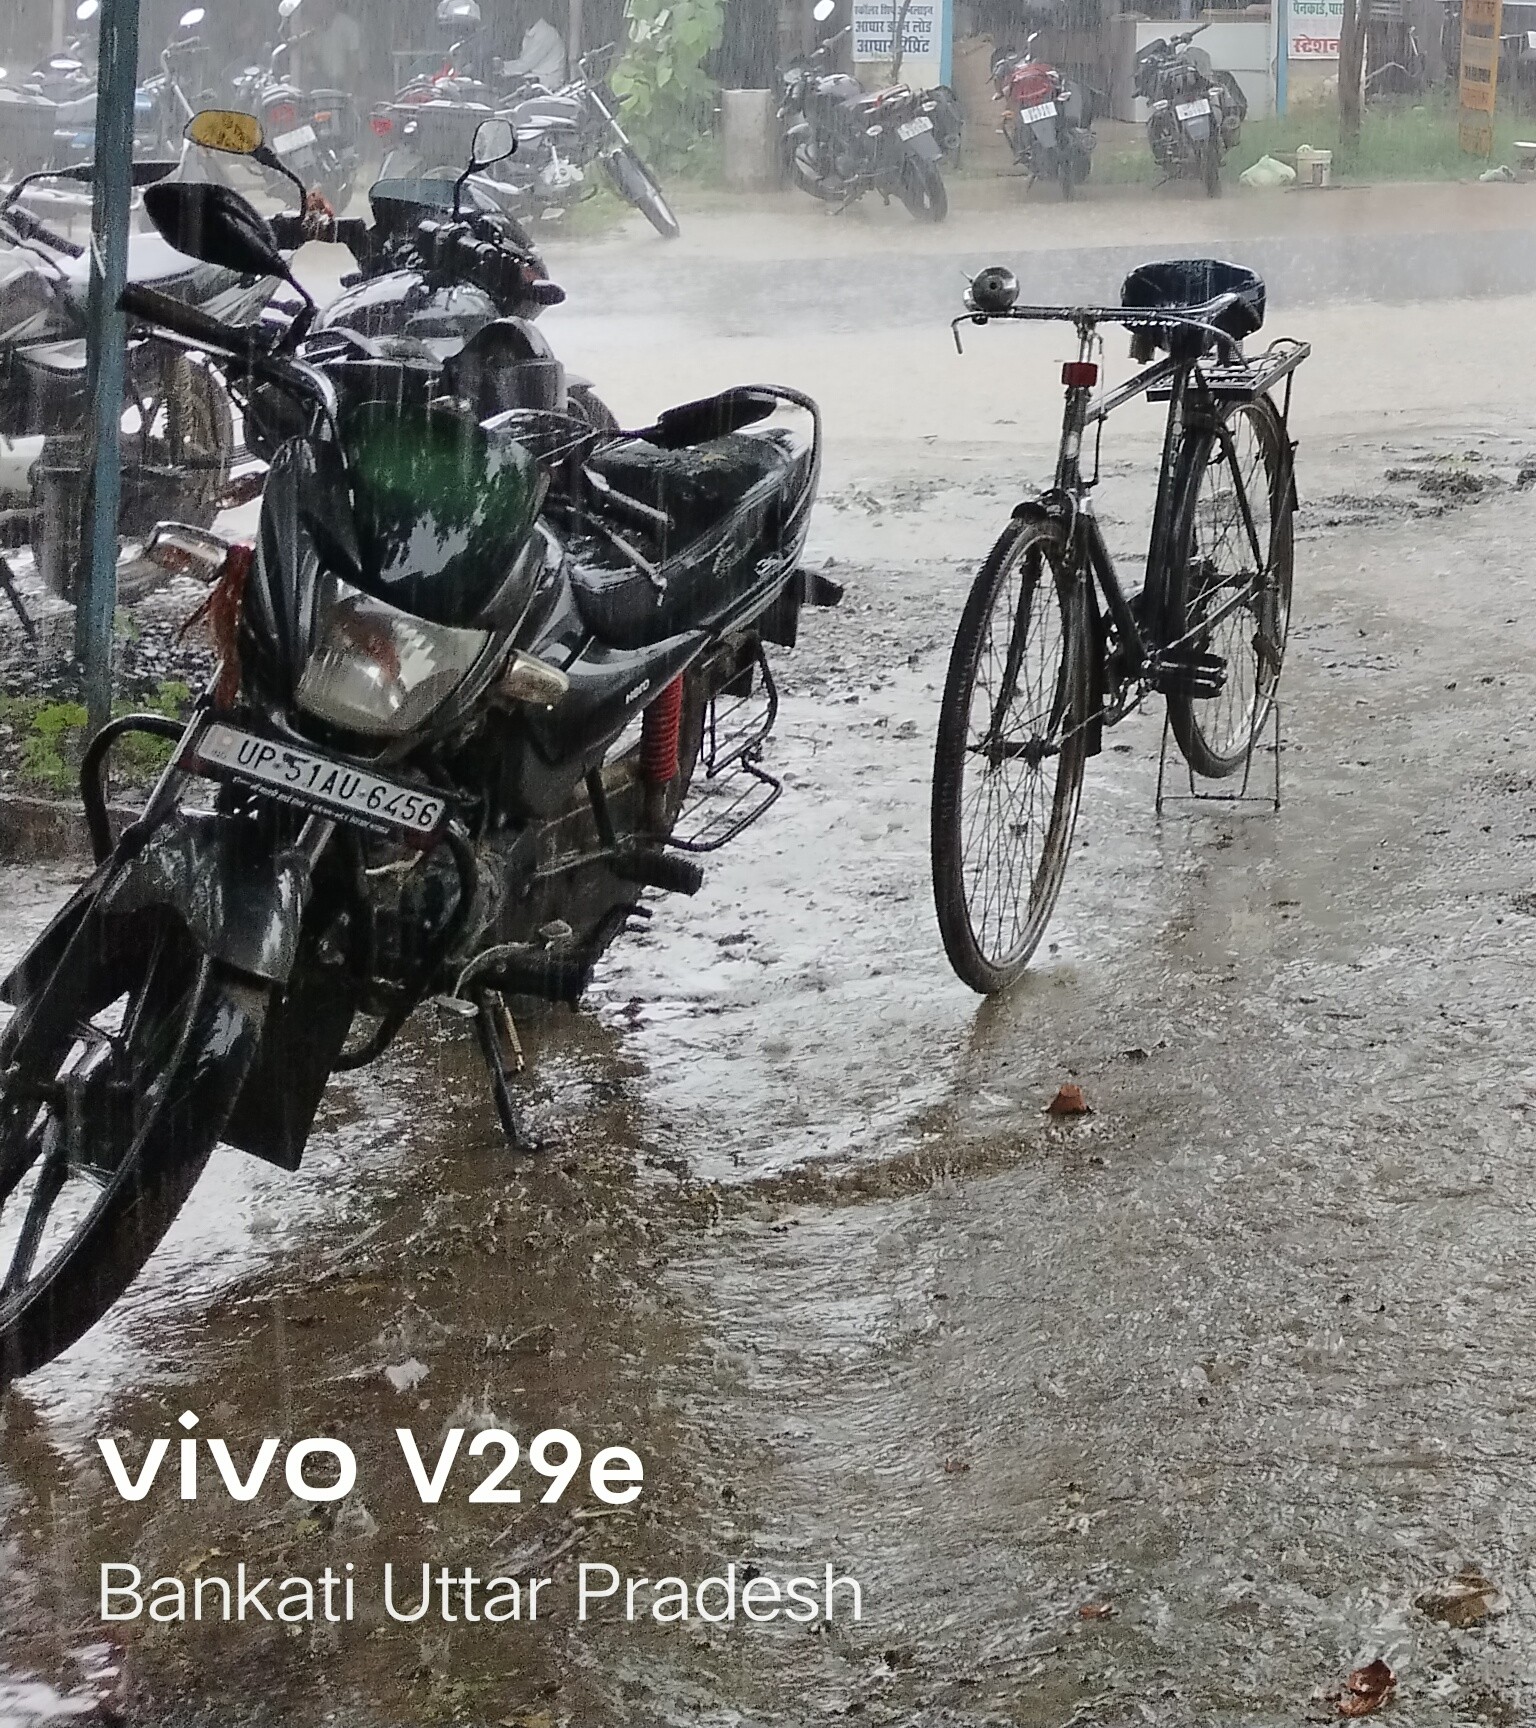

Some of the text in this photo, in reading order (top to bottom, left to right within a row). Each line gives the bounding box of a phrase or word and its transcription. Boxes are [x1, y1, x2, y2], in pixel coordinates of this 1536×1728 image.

[855, 20, 885, 33] आधार
[912, 18, 932, 33] लोड
[366, 785, 439, 828] 6456
